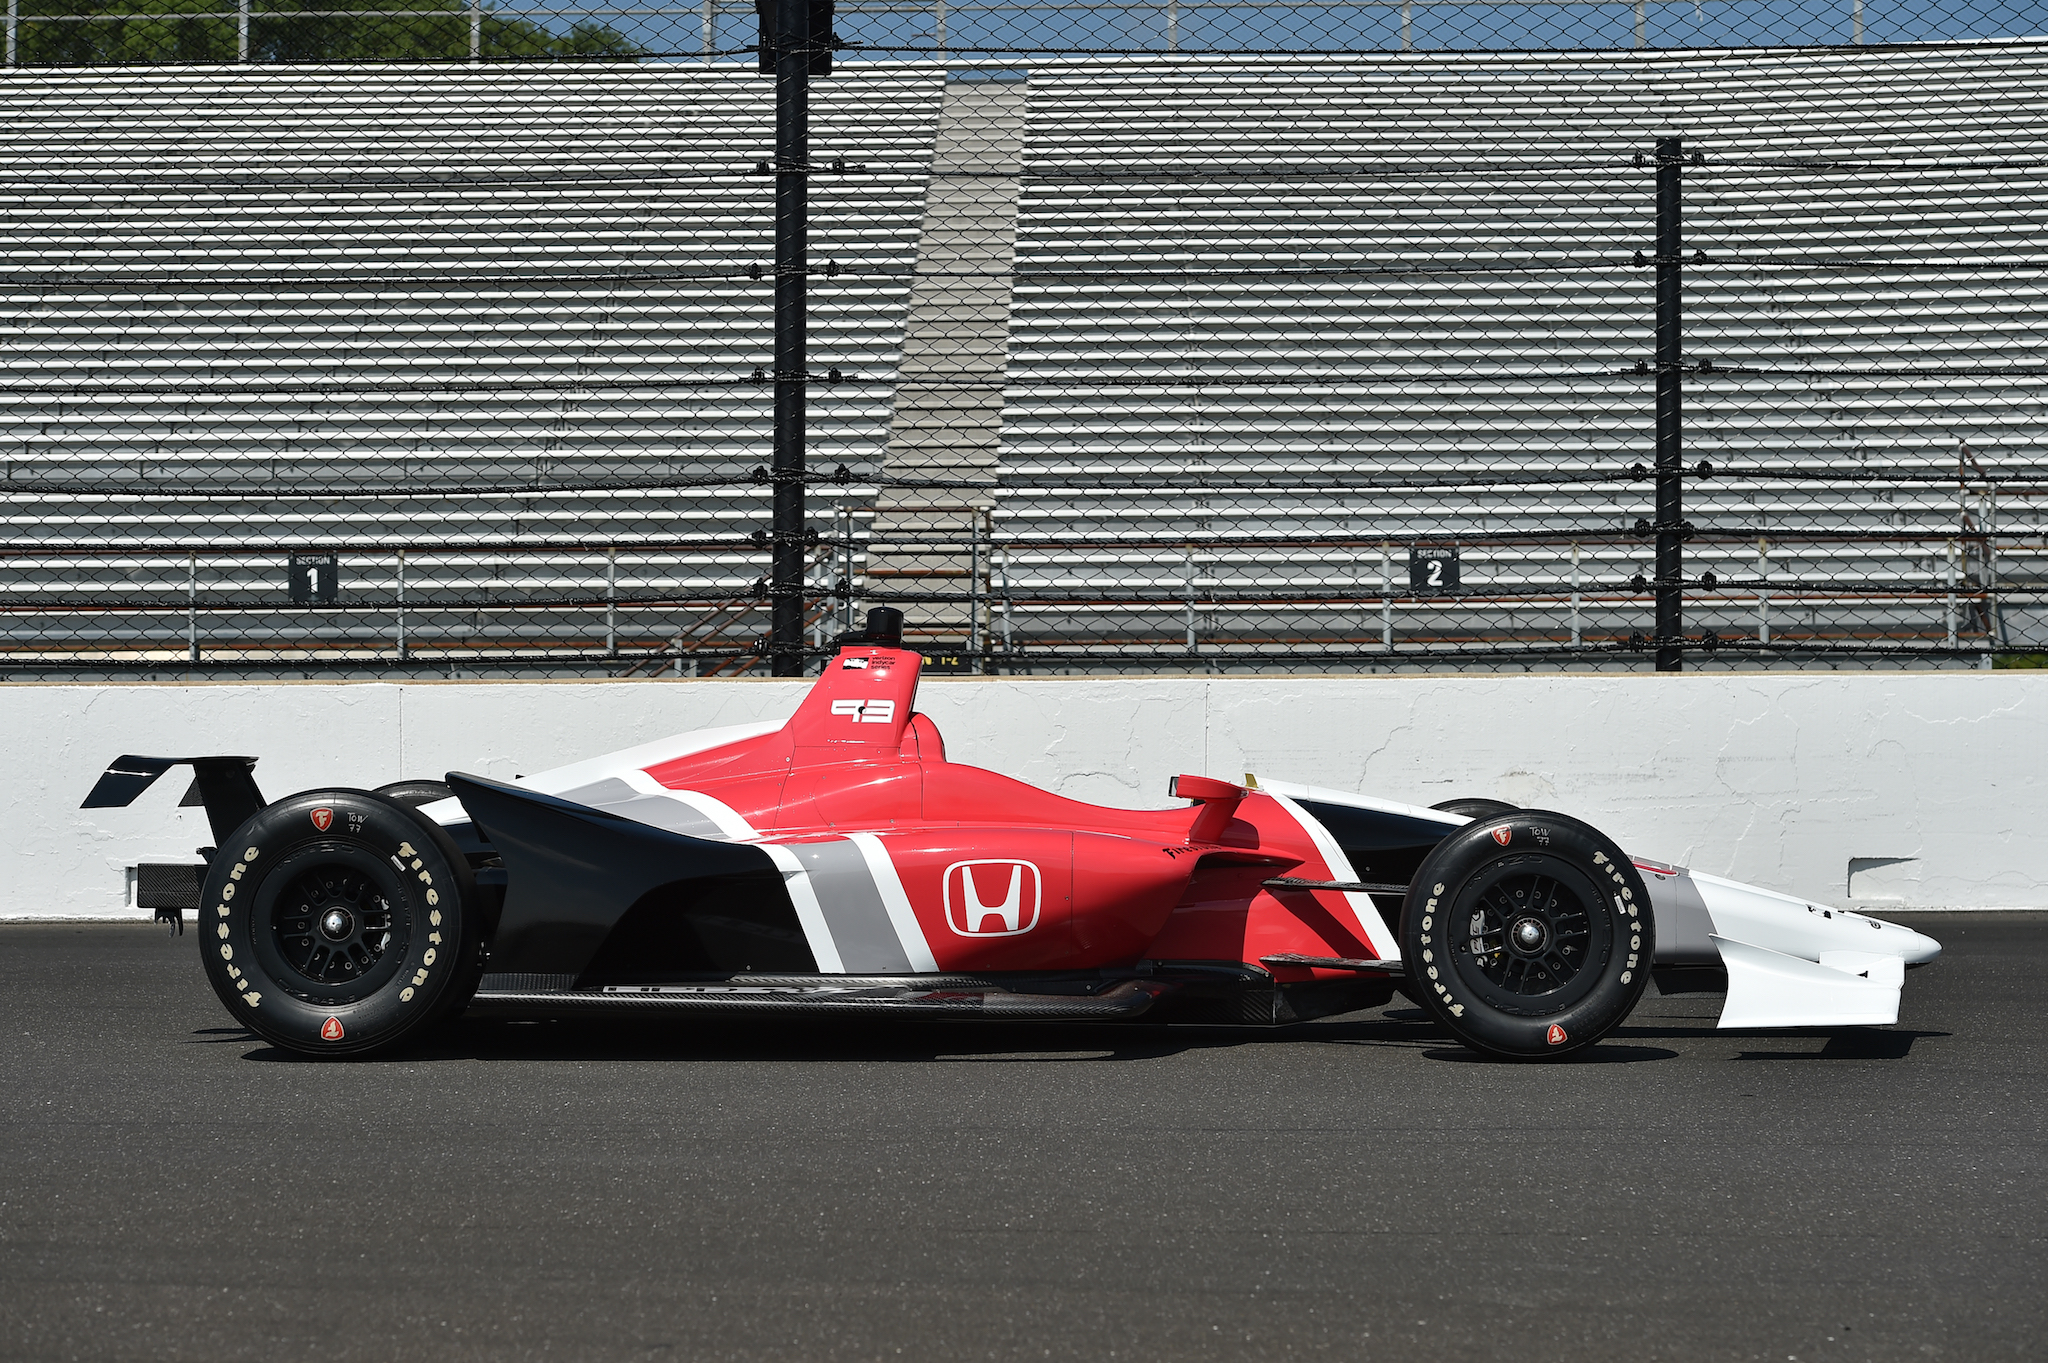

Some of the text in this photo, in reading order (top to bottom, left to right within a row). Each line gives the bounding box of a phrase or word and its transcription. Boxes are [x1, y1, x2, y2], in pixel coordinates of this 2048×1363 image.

[296, 556, 330, 565] SECTION
[307, 568, 319, 593] 1
[1417, 549, 1452, 559] SECTION
[1427, 560, 1443, 586] 2
[216, 845, 263, 1008] Firestone
[398, 841, 443, 1003] Firestone
[1420, 882, 1466, 1018] Firestone
[1592, 850, 1643, 985] Firestone
